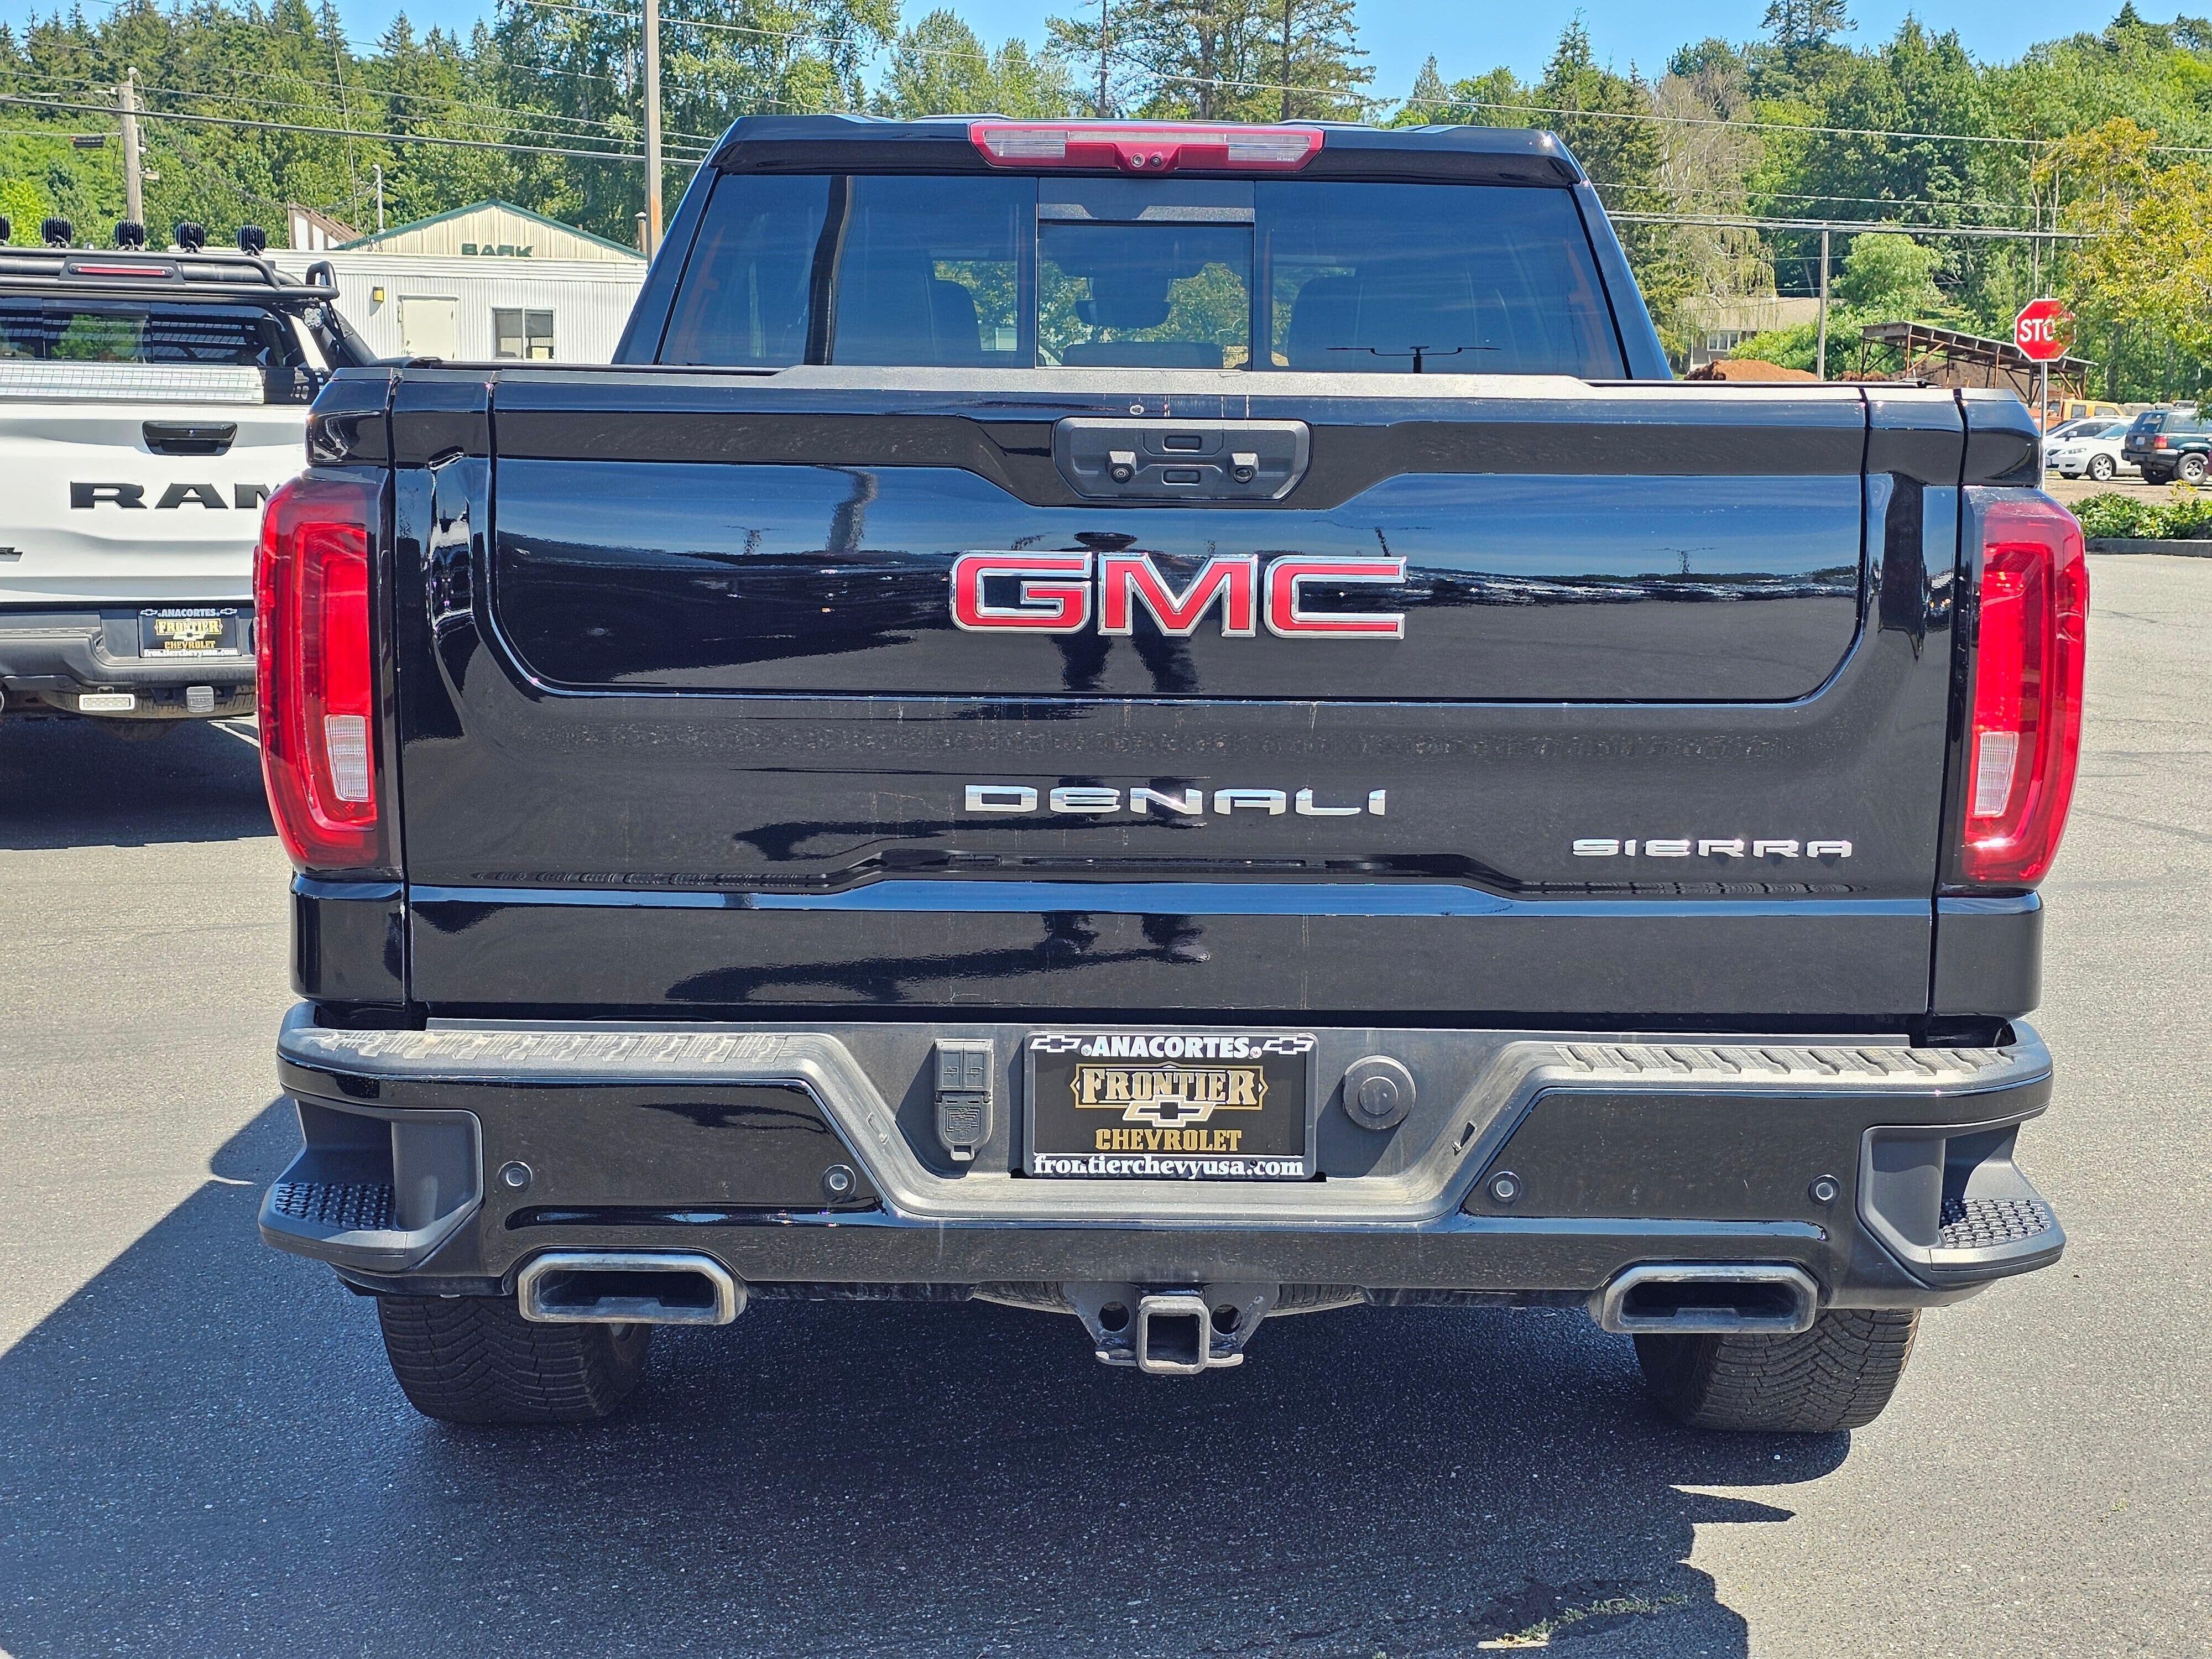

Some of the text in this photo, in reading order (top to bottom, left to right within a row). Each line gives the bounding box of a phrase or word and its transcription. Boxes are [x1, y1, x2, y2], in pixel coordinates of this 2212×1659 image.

[2019, 319, 2057, 342] STO
[949, 551, 1406, 639] GMC
[158, 620, 220, 634] FRONTIER
[164, 640, 216, 649] CHEVROLET
[965, 785, 1386, 816] DENALI
[1572, 839, 1852, 858] SIERRA
[1091, 1036, 1250, 1058] ANACORTES
[1081, 1067, 1258, 1105] FRONTIER
[1095, 1128, 1242, 1151] CHEVROLET
[1034, 1155, 1305, 1180] frontierchevyusa.com
